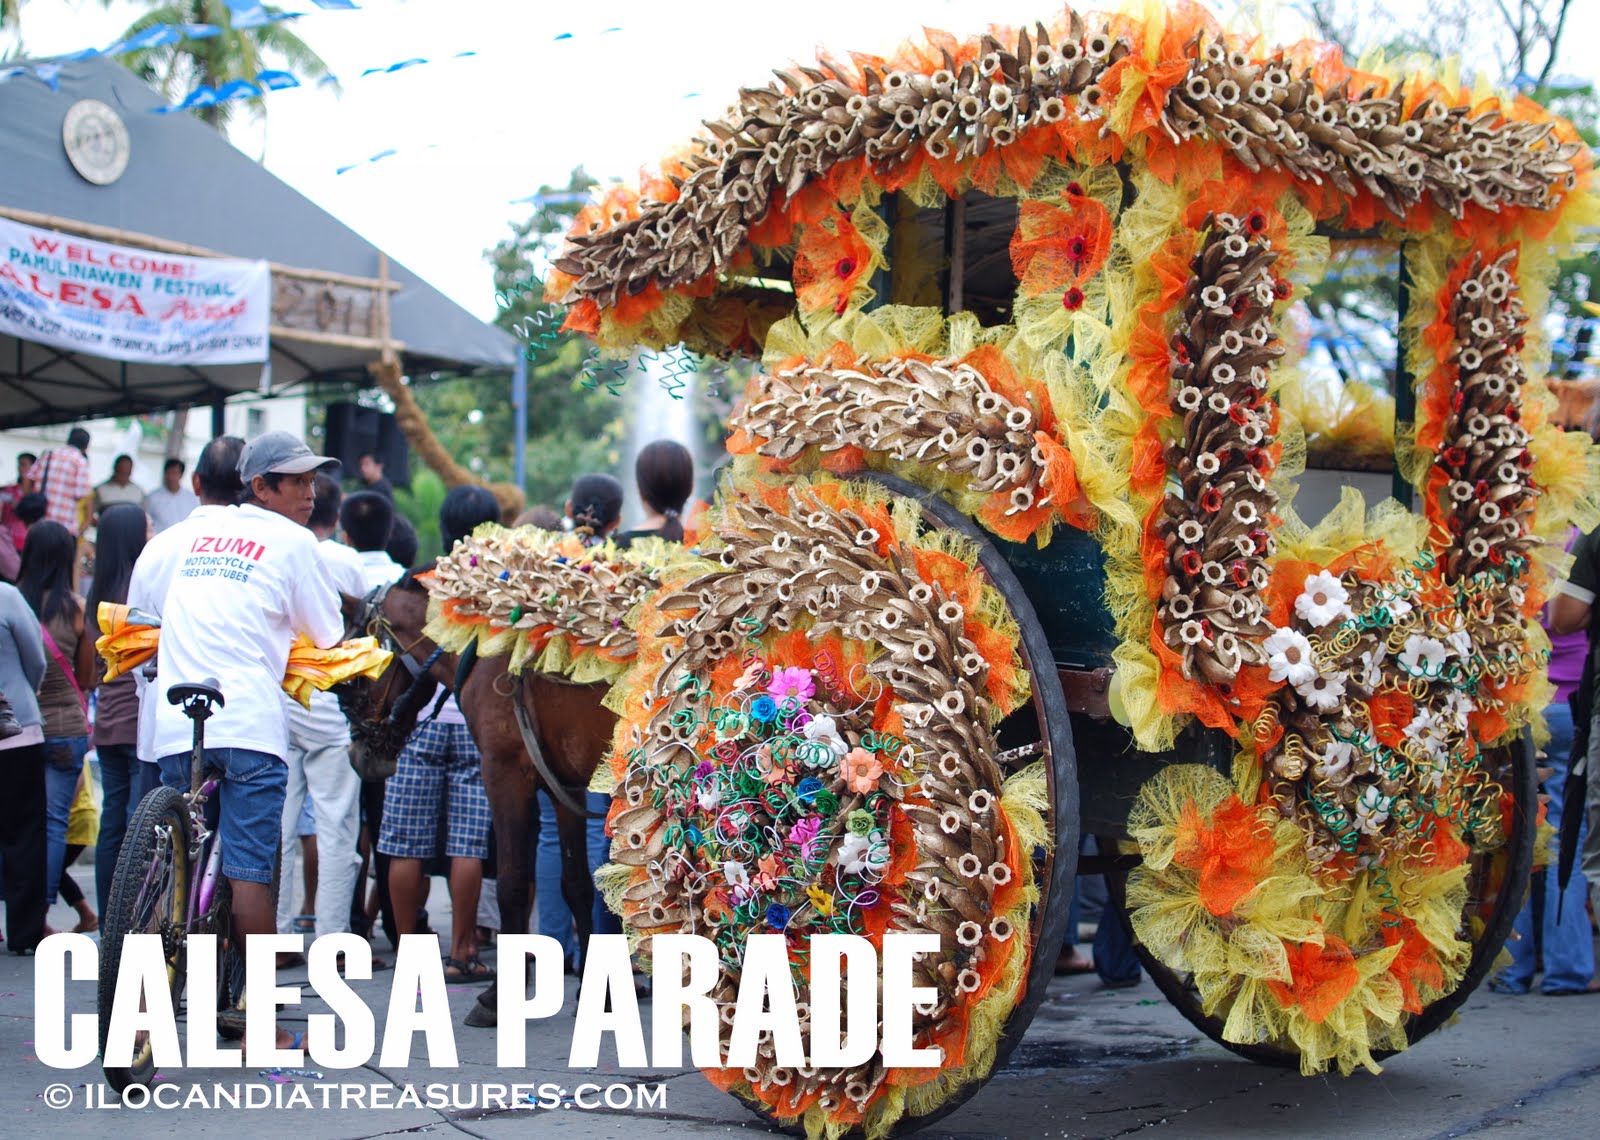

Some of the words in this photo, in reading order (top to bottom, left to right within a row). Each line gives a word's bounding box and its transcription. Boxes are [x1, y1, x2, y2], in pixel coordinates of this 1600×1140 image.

[8, 247, 142, 290] PAMULINAWEN
[153, 277, 236, 297] FESTIVAL
[190, 537, 266, 561] IZUMI
[184, 556, 255, 573] MOTORCYCLE
[201, 567, 217, 577] AND
[218, 568, 249, 584] TUBES
